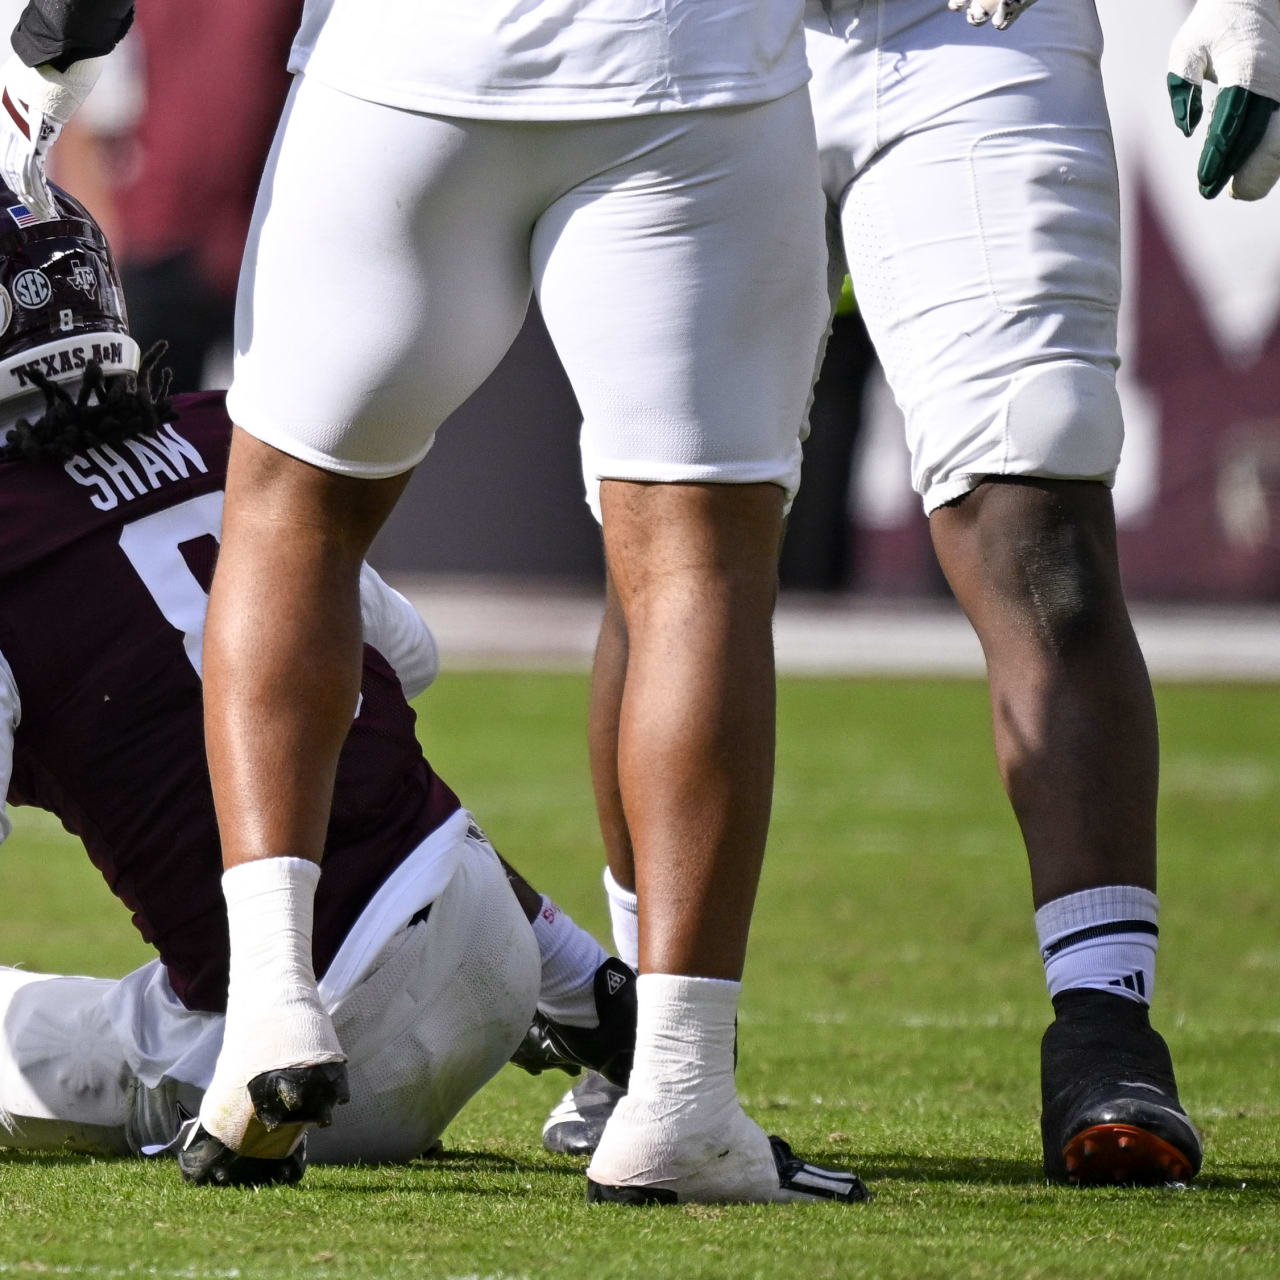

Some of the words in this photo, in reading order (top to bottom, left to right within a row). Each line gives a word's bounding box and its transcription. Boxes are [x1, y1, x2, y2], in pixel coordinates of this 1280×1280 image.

[16, 272, 48, 306] SEC
[59, 308, 74, 331] 8
[92, 342, 122, 364] A&M
[64, 423, 208, 511] SHAW
